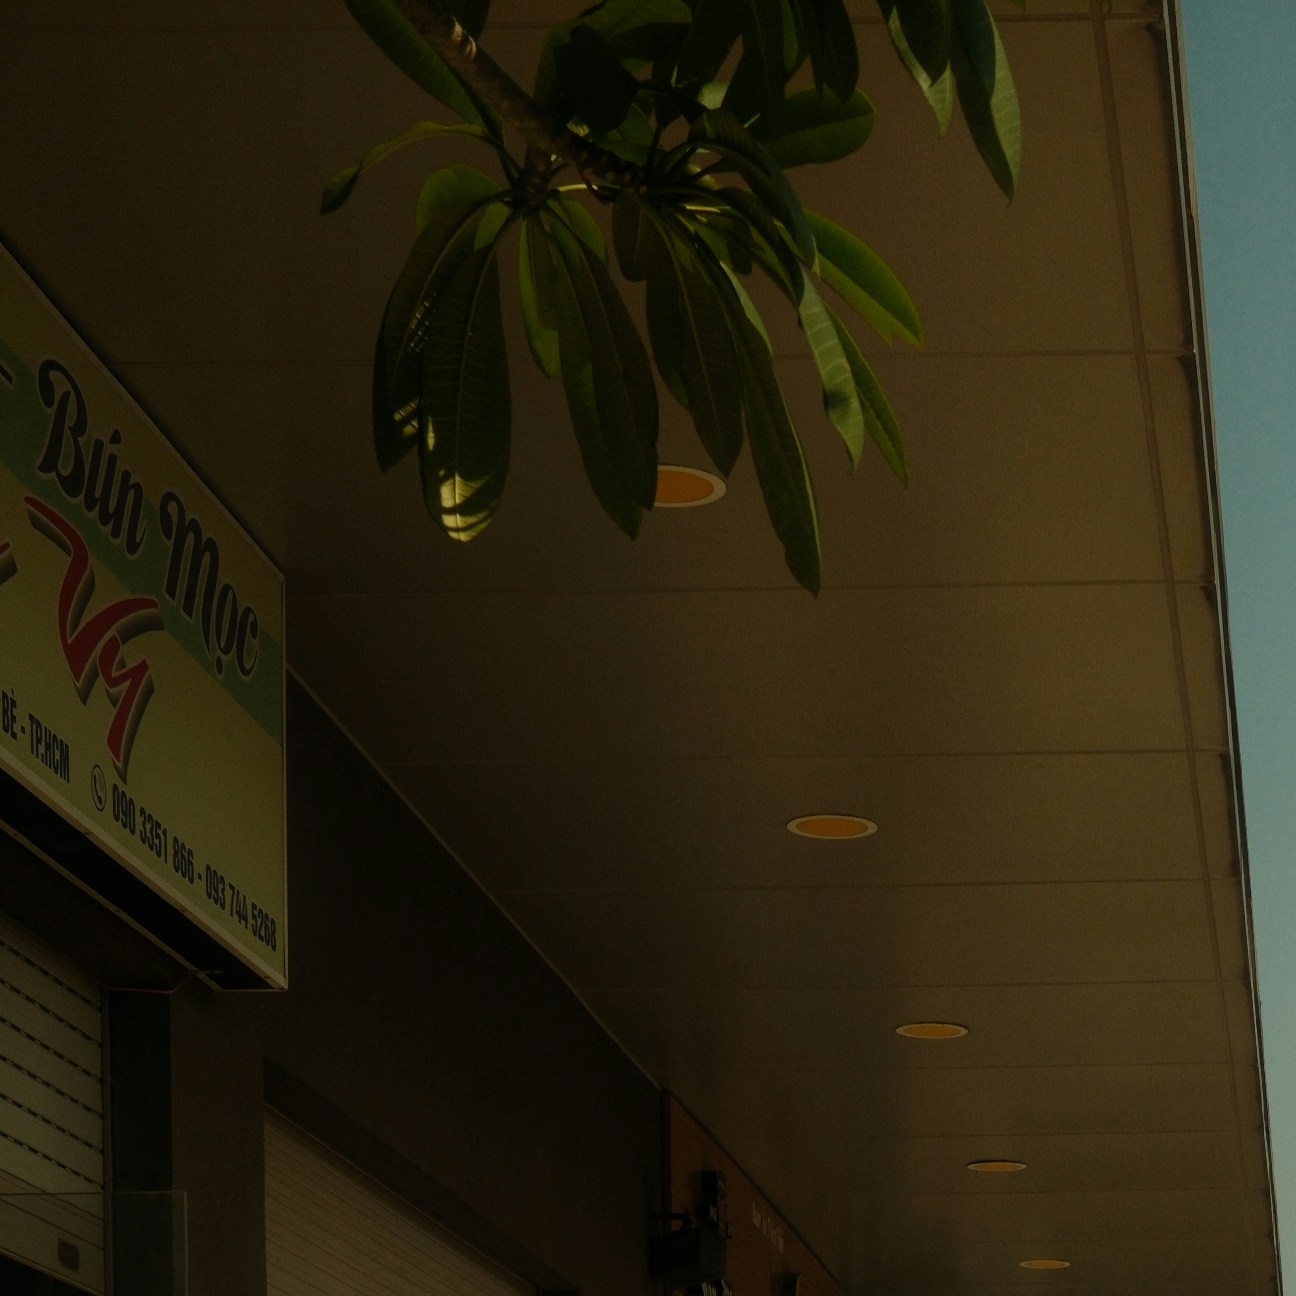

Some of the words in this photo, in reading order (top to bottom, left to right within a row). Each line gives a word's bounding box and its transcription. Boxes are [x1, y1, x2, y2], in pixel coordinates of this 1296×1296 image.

[37, 359, 147, 556] Bún
[159, 491, 259, 677] Mọc
[28, 712, 71, 784] TP.HCM
[112, 783, 136, 836] 090
[139, 806, 168, 865] 3351
[173, 836, 195, 885] 866
[205, 864, 226, 911] 093
[228, 883, 249, 930] 744
[251, 901, 278, 952] 5268
